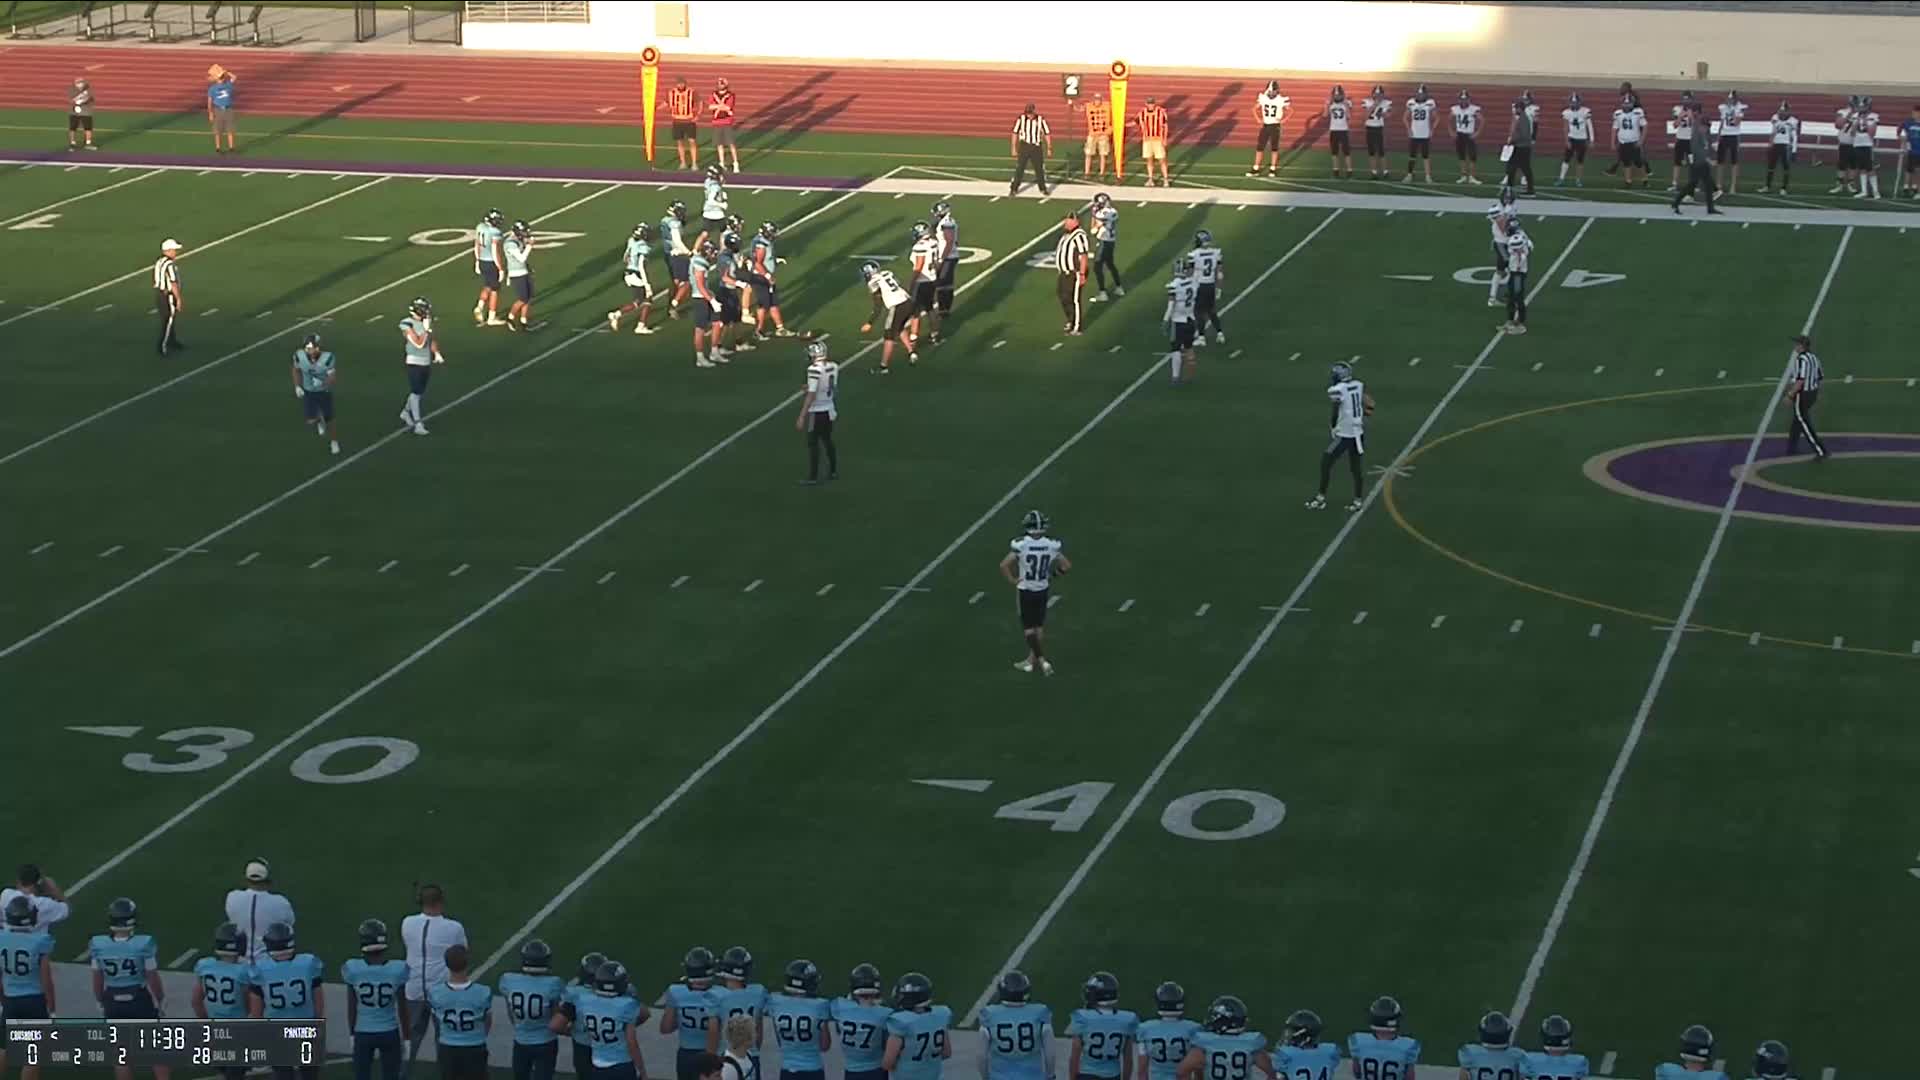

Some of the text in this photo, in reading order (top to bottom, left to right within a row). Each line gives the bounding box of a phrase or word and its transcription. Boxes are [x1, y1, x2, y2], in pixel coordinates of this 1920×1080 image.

[1065, 75, 1079, 95] 2
[1203, 258, 1213, 277] 3
[1185, 288, 1194, 306] 2
[1351, 392, 1361, 418] 11
[1025, 553, 1051, 580] 30
[1, 949, 30, 977] 16
[104, 958, 138, 977] 54
[203, 974, 235, 1005] 62
[269, 979, 306, 1009] 53
[360, 982, 393, 1008] 26
[511, 991, 543, 1020] 80
[777, 1014, 813, 1042] 28
[842, 1020, 876, 1049] 27
[997, 1021, 1035, 1053] 58
[911, 1029, 946, 1062] 79
[1088, 1032, 1123, 1060] 23
[1152, 1037, 1187, 1064] 33
[1211, 1051, 1247, 1080] 69
